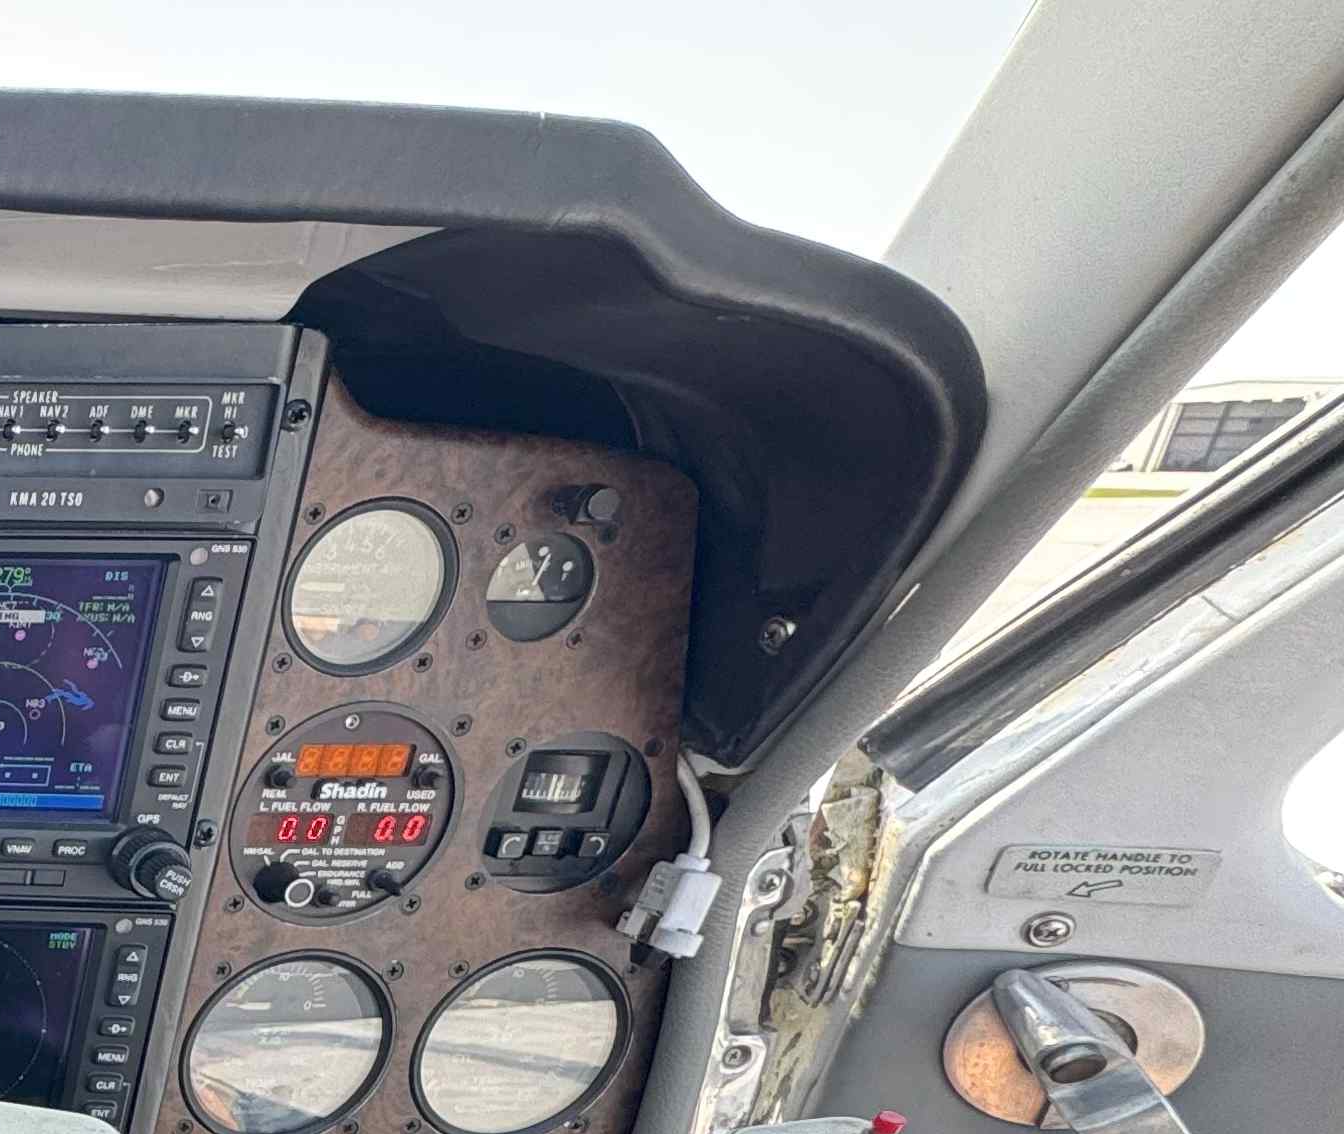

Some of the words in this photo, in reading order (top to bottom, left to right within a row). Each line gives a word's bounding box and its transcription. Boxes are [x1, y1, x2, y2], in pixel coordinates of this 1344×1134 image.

[13, 391, 59, 403] SPEAKER
[222, 392, 245, 405] MKR
[40, 406, 61, 417] NAV
[62, 406, 69, 417] 2
[89, 406, 110, 418] ADF
[130, 406, 154, 418] DME
[175, 406, 198, 418] MKR
[10, 444, 43, 456] PHONE
[212, 445, 237, 458] TEST
[10, 492, 37, 507] KMA
[40, 492, 56, 506] 20
[61, 492, 83, 507] TSO
[191, 611, 213, 621] RNG
[167, 706, 197, 716] MENU
[70, 762, 92, 772] ETA
[159, 772, 180, 782] ENT
[320, 783, 388, 800] Shadin
[370, 803, 398, 812] FUEL
[398, 803, 431, 813] FLOW
[137, 814, 160, 824] GPS
[58, 843, 87, 856] PROC
[1028, 850, 1090, 862] ROTATE
[1095, 851, 1162, 864] HANDLE
[1167, 853, 1193, 864] TO
[1014, 862, 1047, 873] FULL
[1053, 862, 1114, 875] LOCKED
[1119, 864, 1200, 877] POSITION
[98, 1052, 126, 1063] MENU
